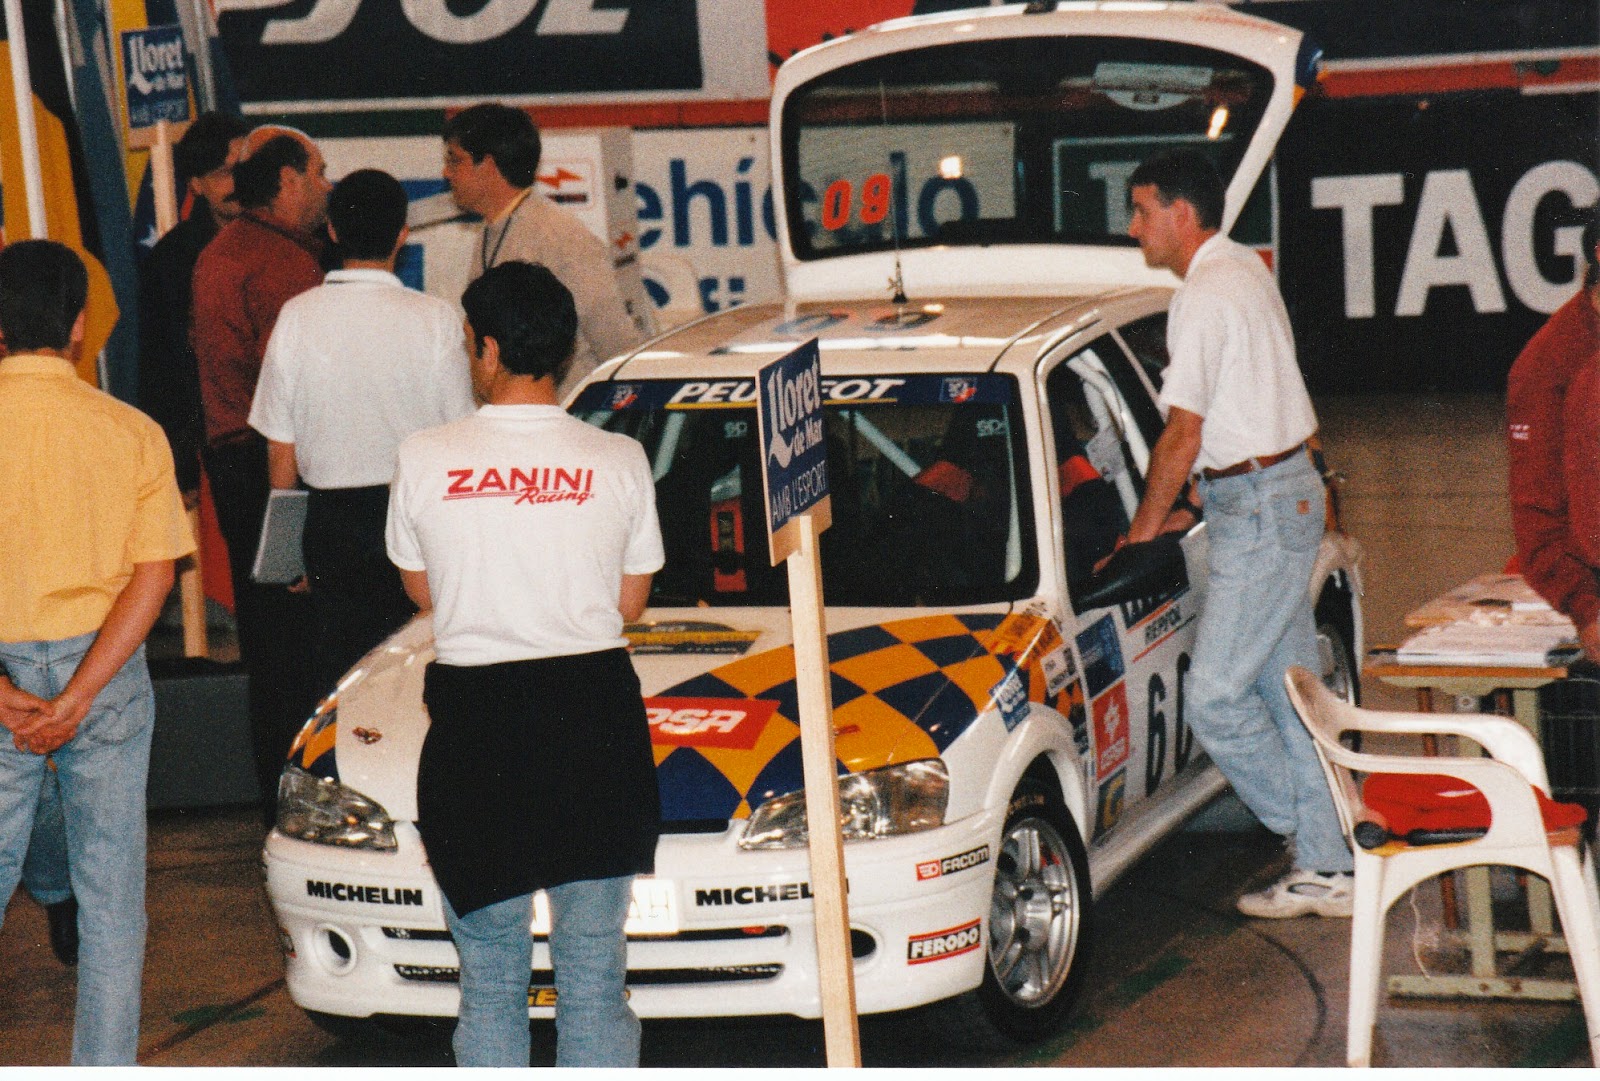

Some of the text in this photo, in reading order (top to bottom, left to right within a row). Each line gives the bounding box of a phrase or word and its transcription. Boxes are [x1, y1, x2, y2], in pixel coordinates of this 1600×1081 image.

[667, 379, 905, 404] PEUOT
[447, 467, 594, 494] ZANINI
[514, 486, 592, 505] Racing
[772, 485, 792, 525] AMB
[646, 707, 747, 735] PSA
[306, 879, 423, 906] MICHELIN
[695, 878, 849, 906] MICHEL
[910, 928, 979, 959] FERODO
